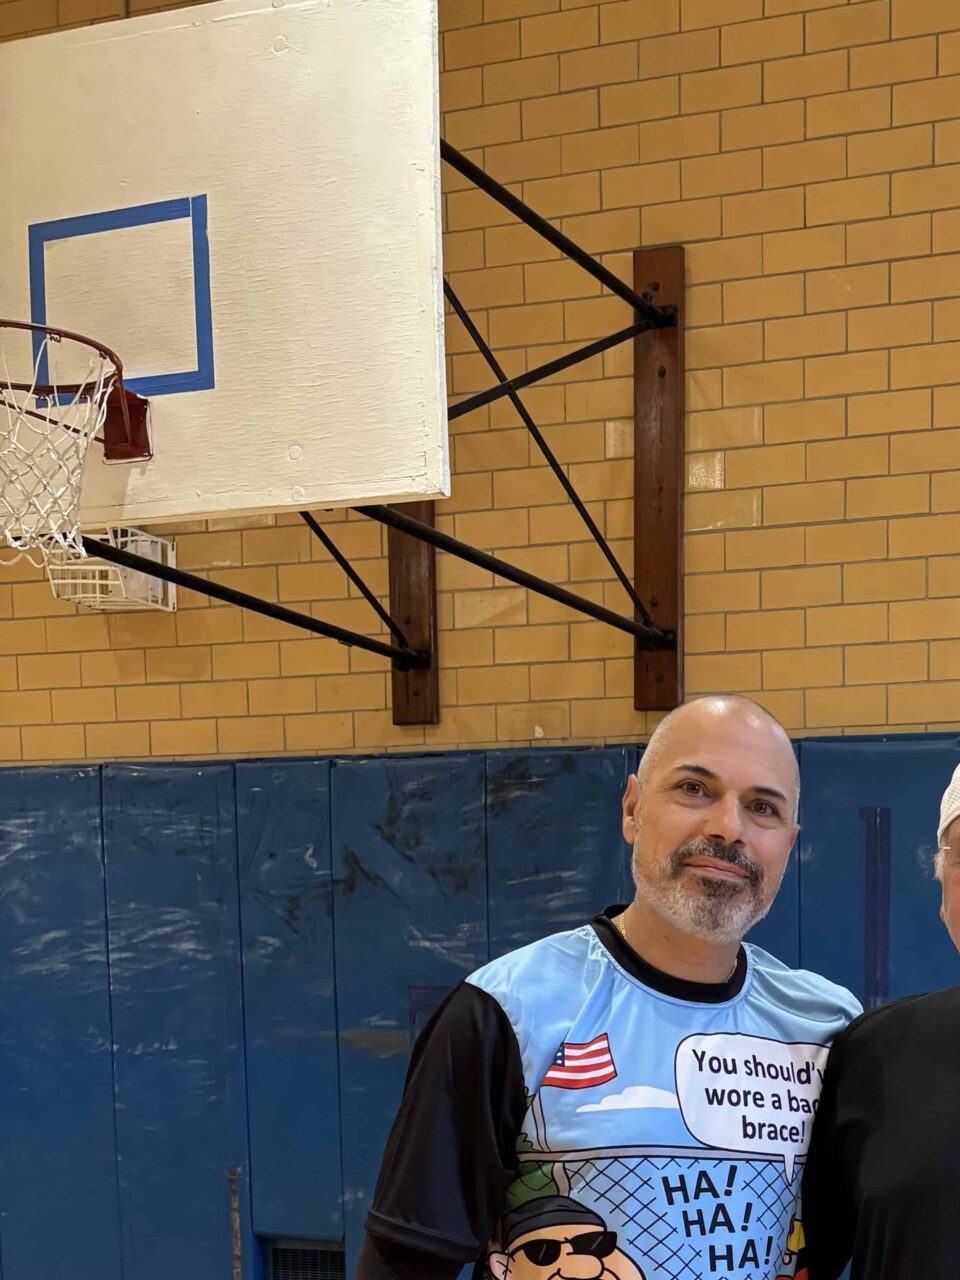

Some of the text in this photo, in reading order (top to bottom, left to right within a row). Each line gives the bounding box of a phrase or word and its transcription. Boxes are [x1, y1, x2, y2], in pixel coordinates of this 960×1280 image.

[692, 1049, 737, 1074] You
[705, 1087, 765, 1109] wore
[771, 1093, 783, 1111] a
[742, 1115, 806, 1144] brace!
[661, 1165, 738, 1206] HA!
[682, 1202, 753, 1238] HA!
[709, 1236, 773, 1272] HA!
